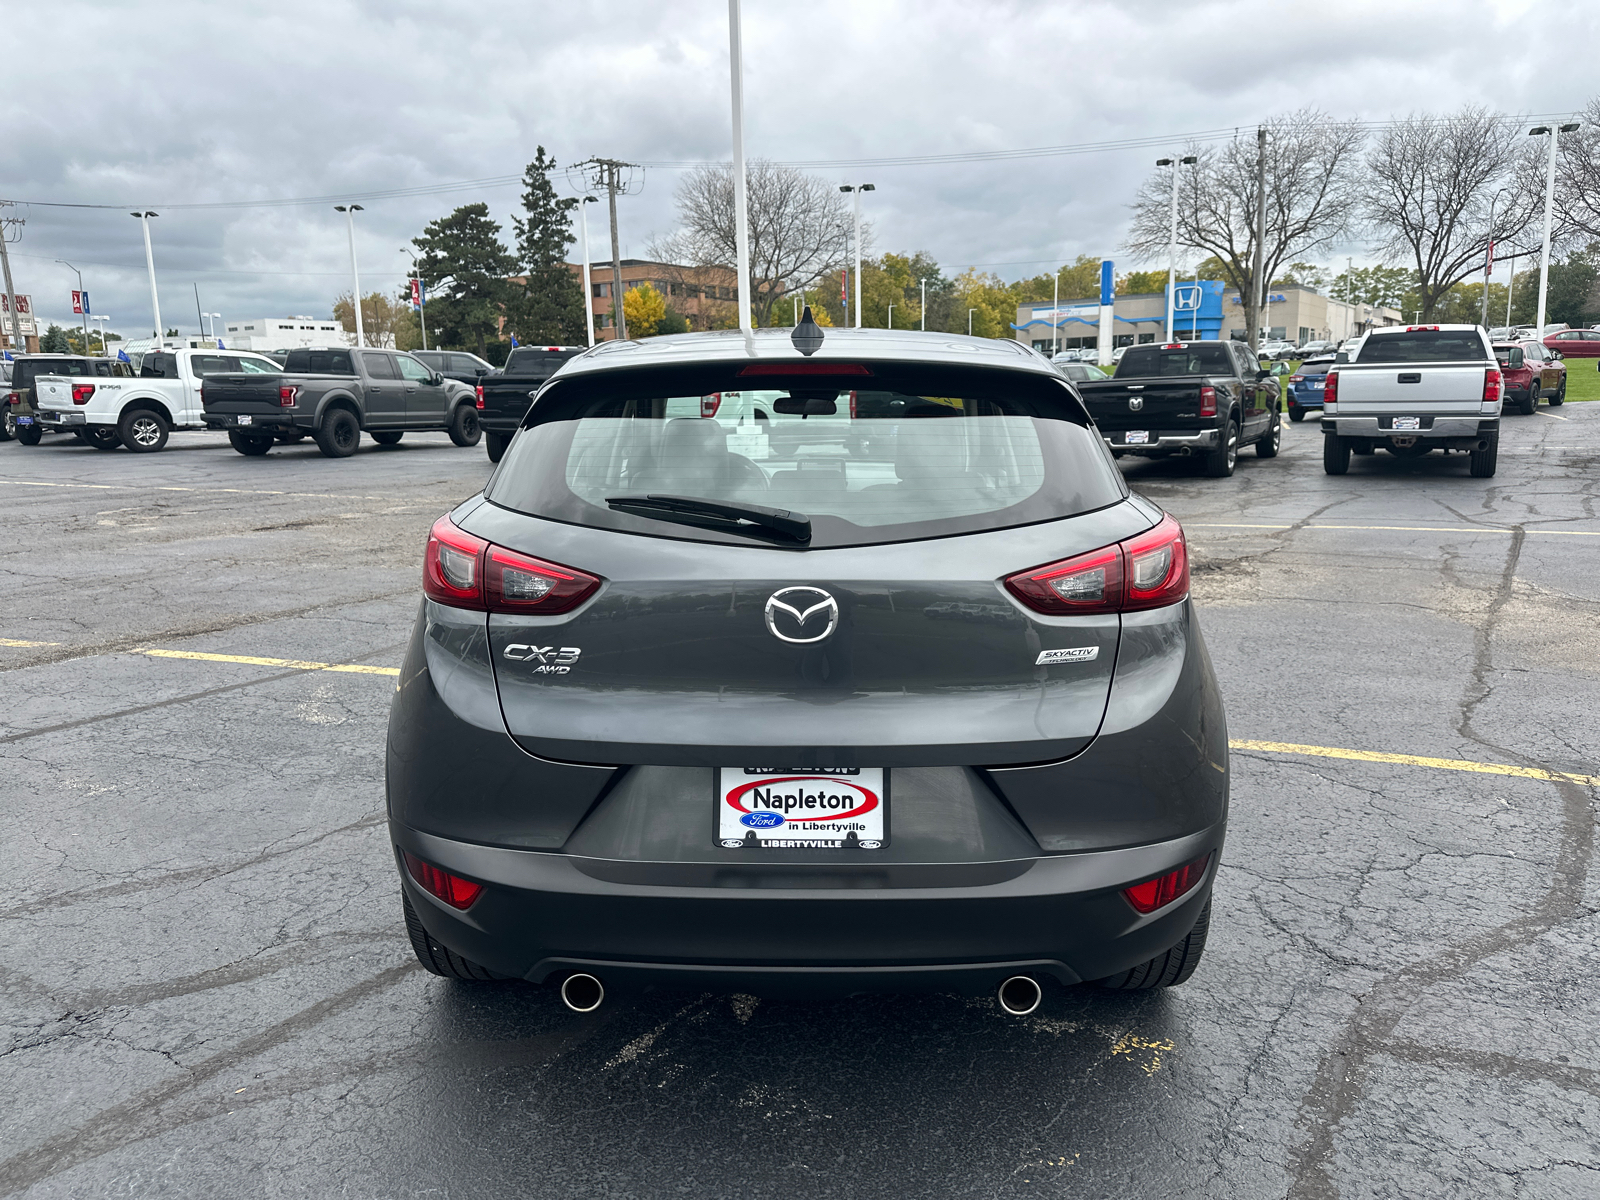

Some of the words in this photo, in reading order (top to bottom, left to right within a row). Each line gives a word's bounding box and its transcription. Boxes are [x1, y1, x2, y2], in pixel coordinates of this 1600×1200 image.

[503, 643, 582, 665] CX-3
[1045, 648, 1094, 658] SKYACTIV
[532, 665, 571, 675] AWD
[753, 788, 854, 814] Napleton
[749, 814, 776, 827] Ford
[788, 822, 799, 831] in
[802, 822, 866, 832] Libertyville
[761, 840, 842, 848] LIBERTYVILLE
